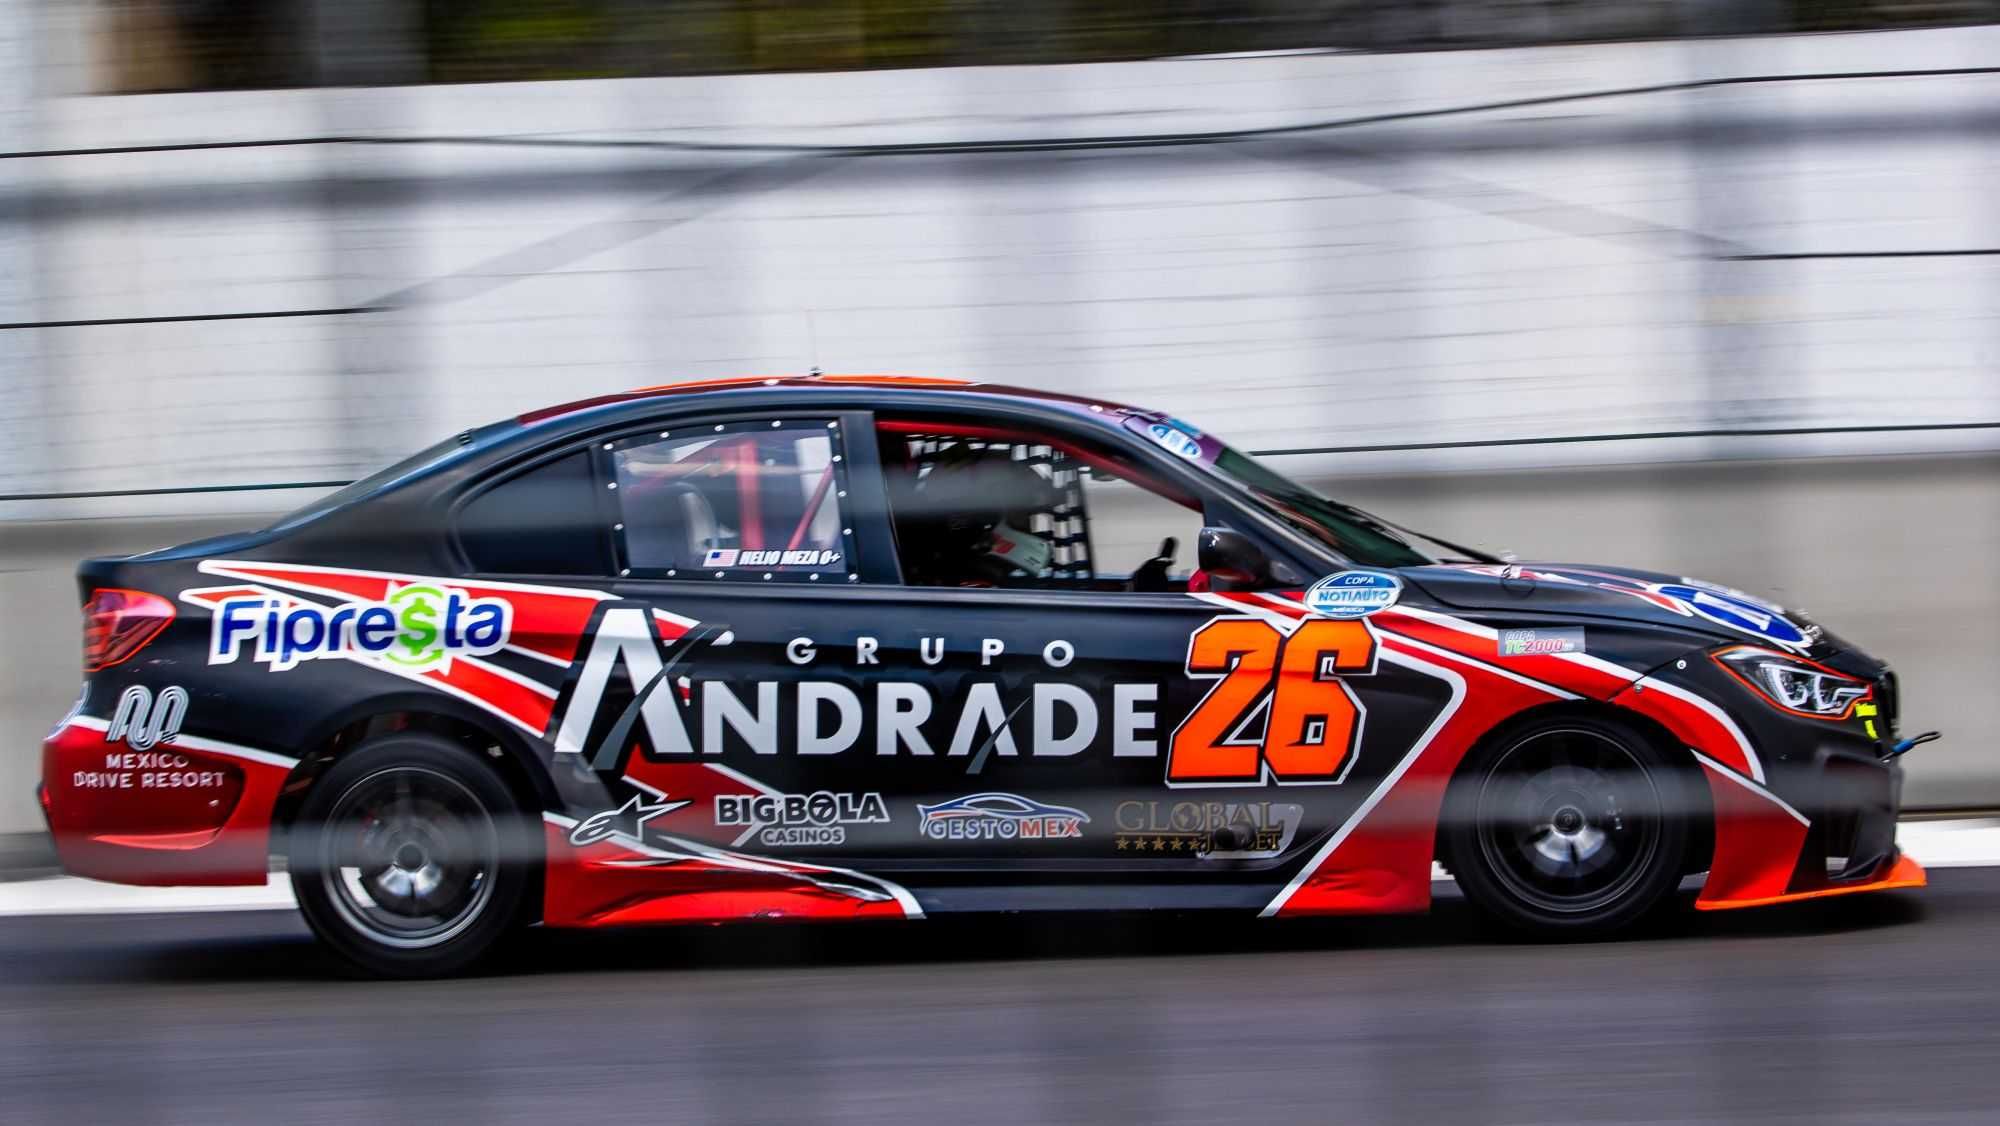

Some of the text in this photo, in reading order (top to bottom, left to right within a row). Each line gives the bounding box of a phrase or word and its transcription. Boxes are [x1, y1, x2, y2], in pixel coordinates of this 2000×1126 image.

[738, 550, 780, 566] HELIO
[780, 550, 819, 566] MEZA
[1344, 576, 1375, 585] COPA
[1317, 588, 1391, 602] NOTIAUTO
[786, 637, 1075, 666] GRUPO
[554, 608, 1158, 762] ANDRADE
[1165, 615, 1378, 788] 26
[106, 753, 190, 769] MEXICO
[73, 771, 225, 788] DRIVE RESORT
[716, 791, 890, 826] BIG BOLA
[1114, 801, 1283, 833] GLOBAL
[760, 827, 847, 846] CASINOS
